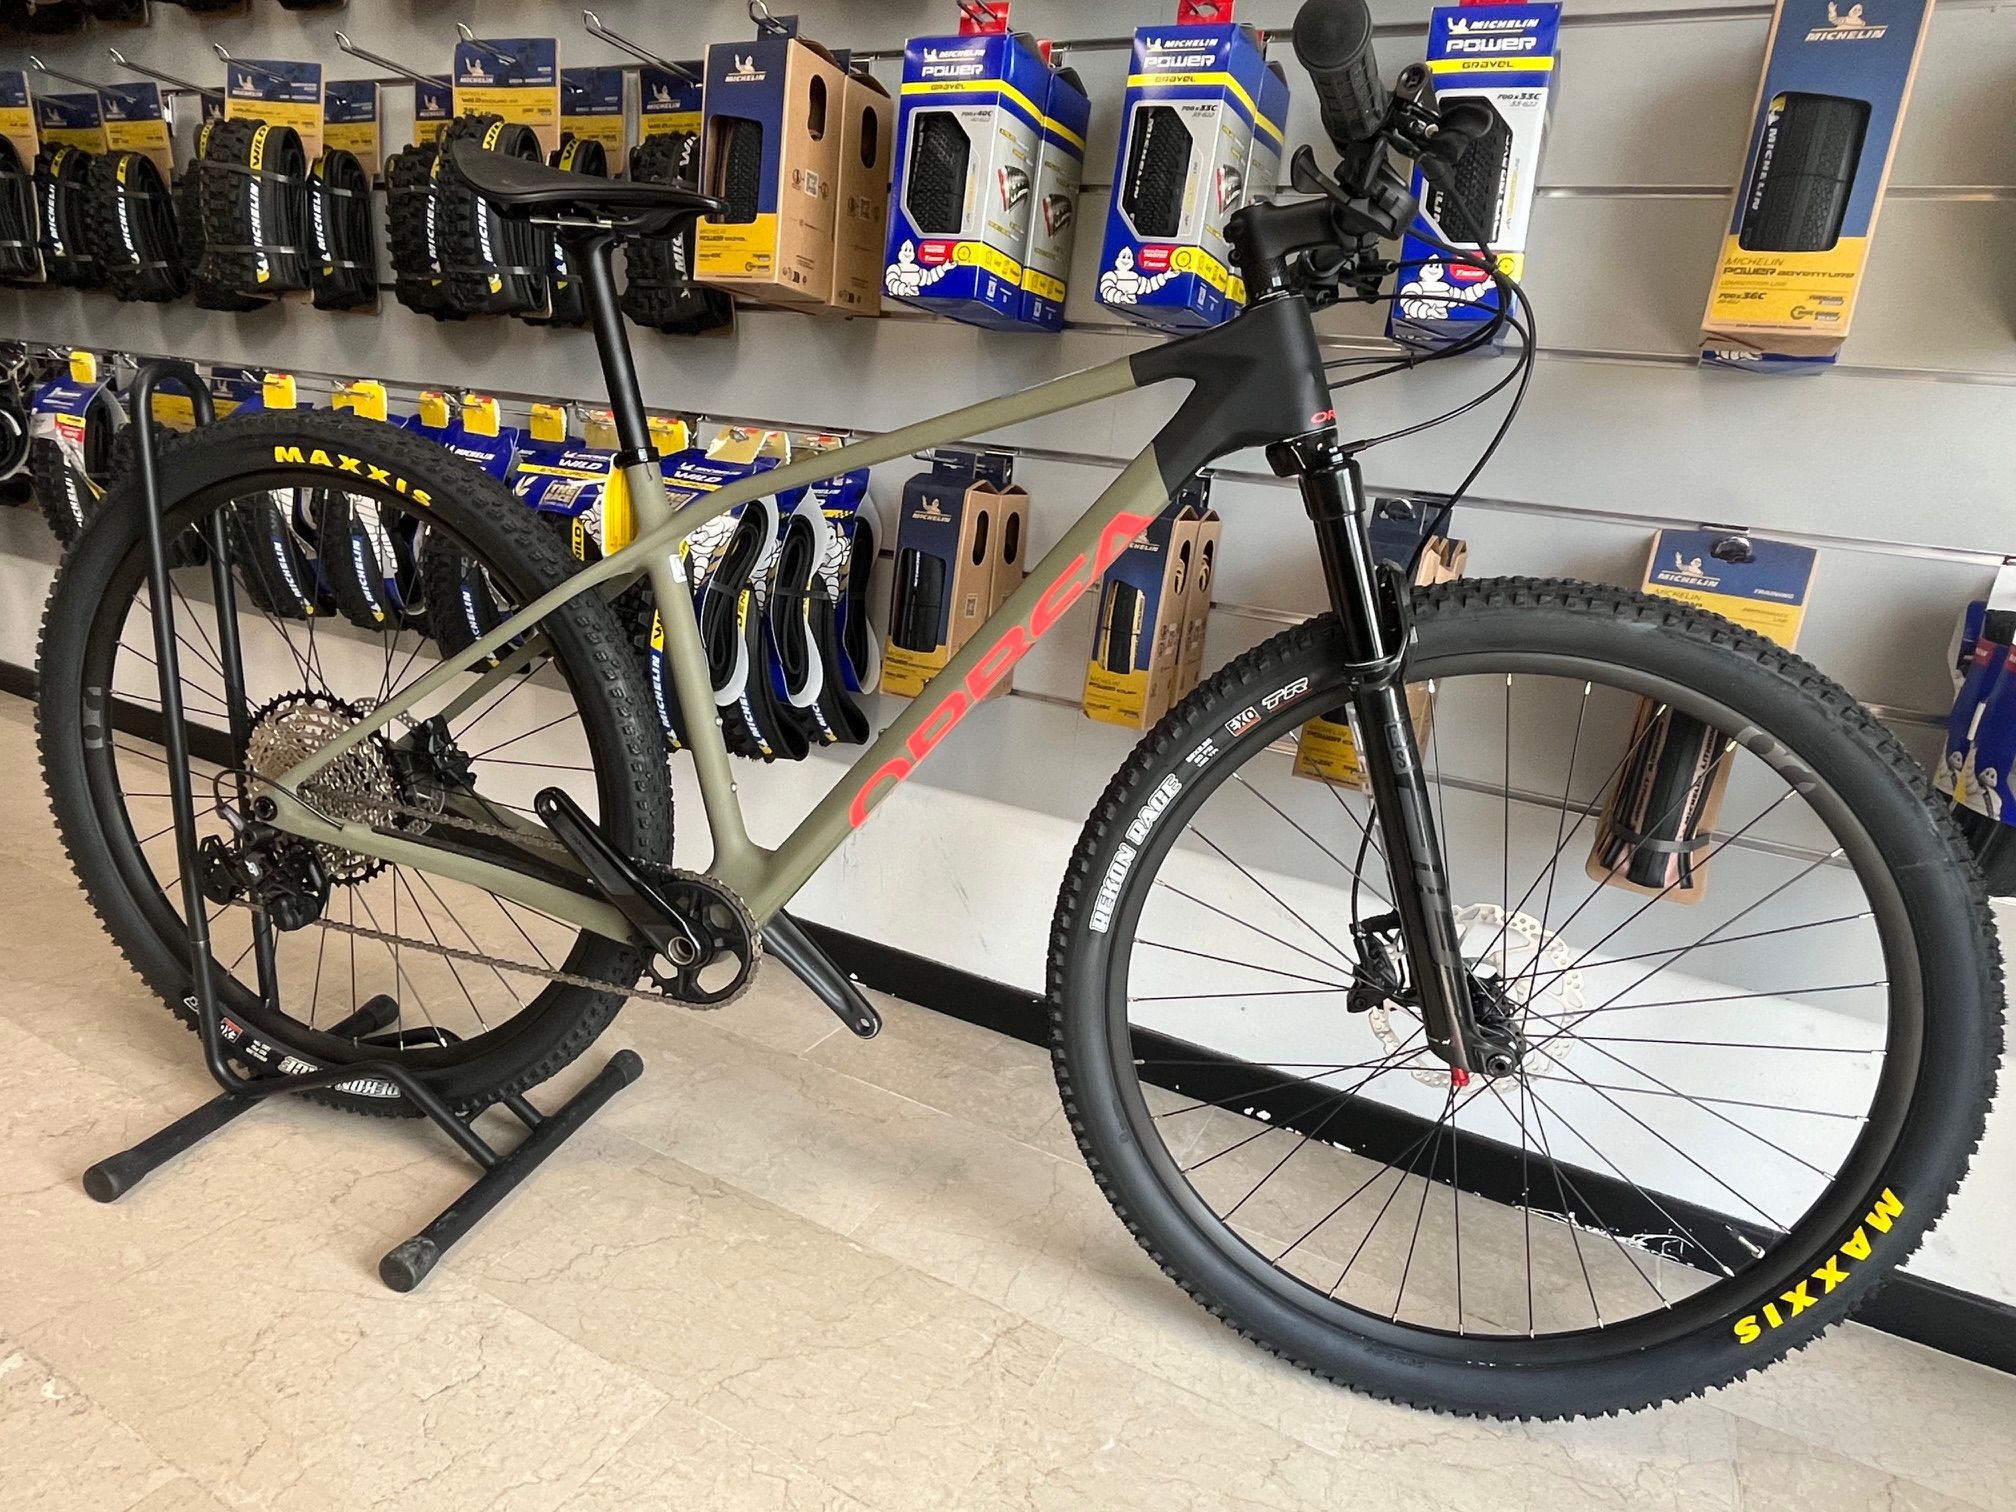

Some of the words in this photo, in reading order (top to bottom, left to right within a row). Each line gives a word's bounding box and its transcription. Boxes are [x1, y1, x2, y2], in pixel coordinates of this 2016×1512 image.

[1469, 18, 1540, 30] MICHELIN
[1805, 28, 1889, 42] MICHELIN
[1163, 38, 1219, 48] MICHELIN
[1445, 36, 1537, 53] POWER
[1143, 54, 1216, 69] POWER
[1461, 60, 1514, 70] GRAVEL
[724, 72, 767, 83] MICHELIN
[921, 64, 984, 78] POWER
[1751, 127, 1779, 211] MICHELIN
[1725, 257, 1785, 267] MICHELIN
[1723, 267, 1777, 276] POWER
[558, 458, 603, 470] WILD
[274, 446, 432, 507] MAXXIS
[911, 512, 952, 523] MICHELIN
[1128, 543, 1160, 552] CHELIN
[1656, 572, 1719, 588] MICHELIN
[1753, 588, 1796, 600] TRAINING
[651, 654, 671, 728] MICHELIN
[1261, 677, 1310, 711] TR
[1228, 706, 1259, 735] EXO
[1089, 843, 1137, 934] REKON
[1125, 773, 1183, 846] RACE
[1733, 1187, 1905, 1344] MAXXIS
